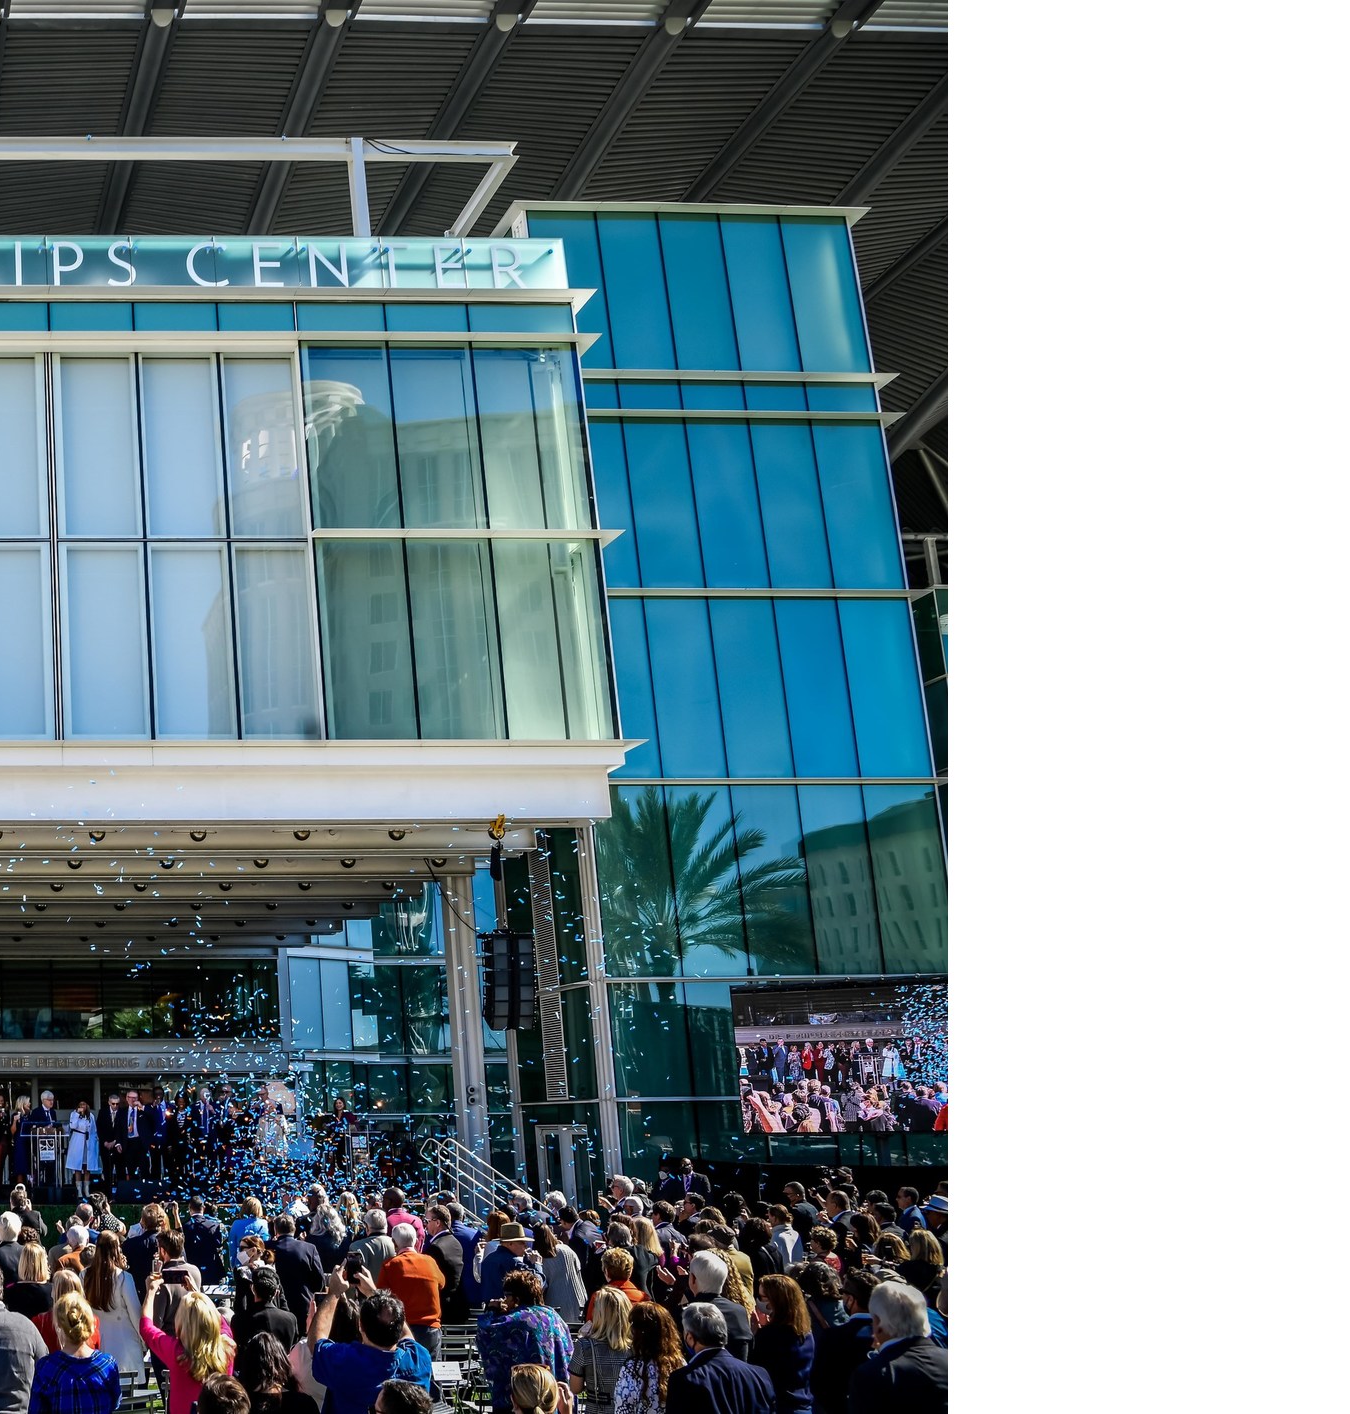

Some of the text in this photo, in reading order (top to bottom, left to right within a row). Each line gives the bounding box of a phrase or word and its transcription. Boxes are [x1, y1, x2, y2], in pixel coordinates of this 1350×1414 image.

[185, 241, 529, 289] CENTER
[0, 1055, 31, 1069] THE
[36, 1055, 140, 1069] PERFORMING
